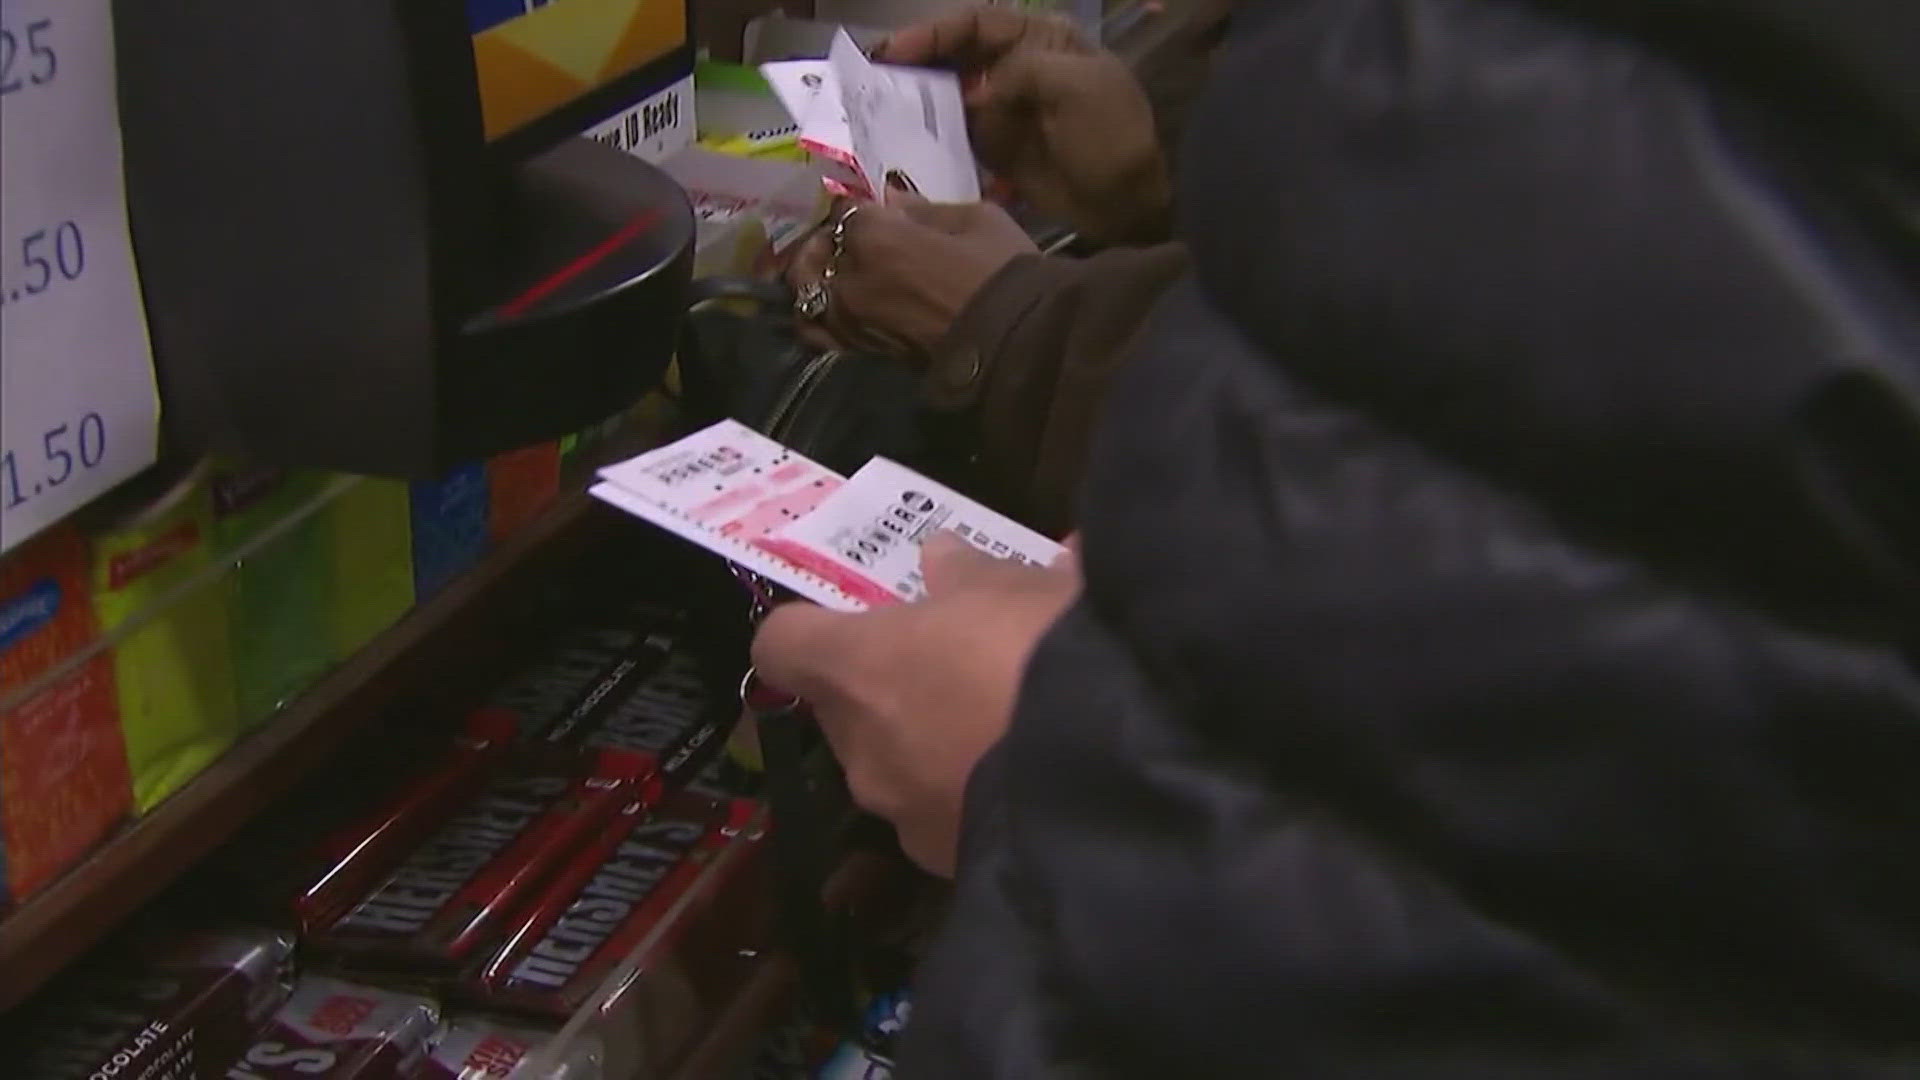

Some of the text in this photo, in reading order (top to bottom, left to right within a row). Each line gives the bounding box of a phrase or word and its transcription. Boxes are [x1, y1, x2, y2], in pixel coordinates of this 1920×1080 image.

[625, 112, 639, 150] ID
[643, 91, 678, 139] Ready
[0, 220, 84, 302] .50
[2, 412, 106, 511] 1.50
